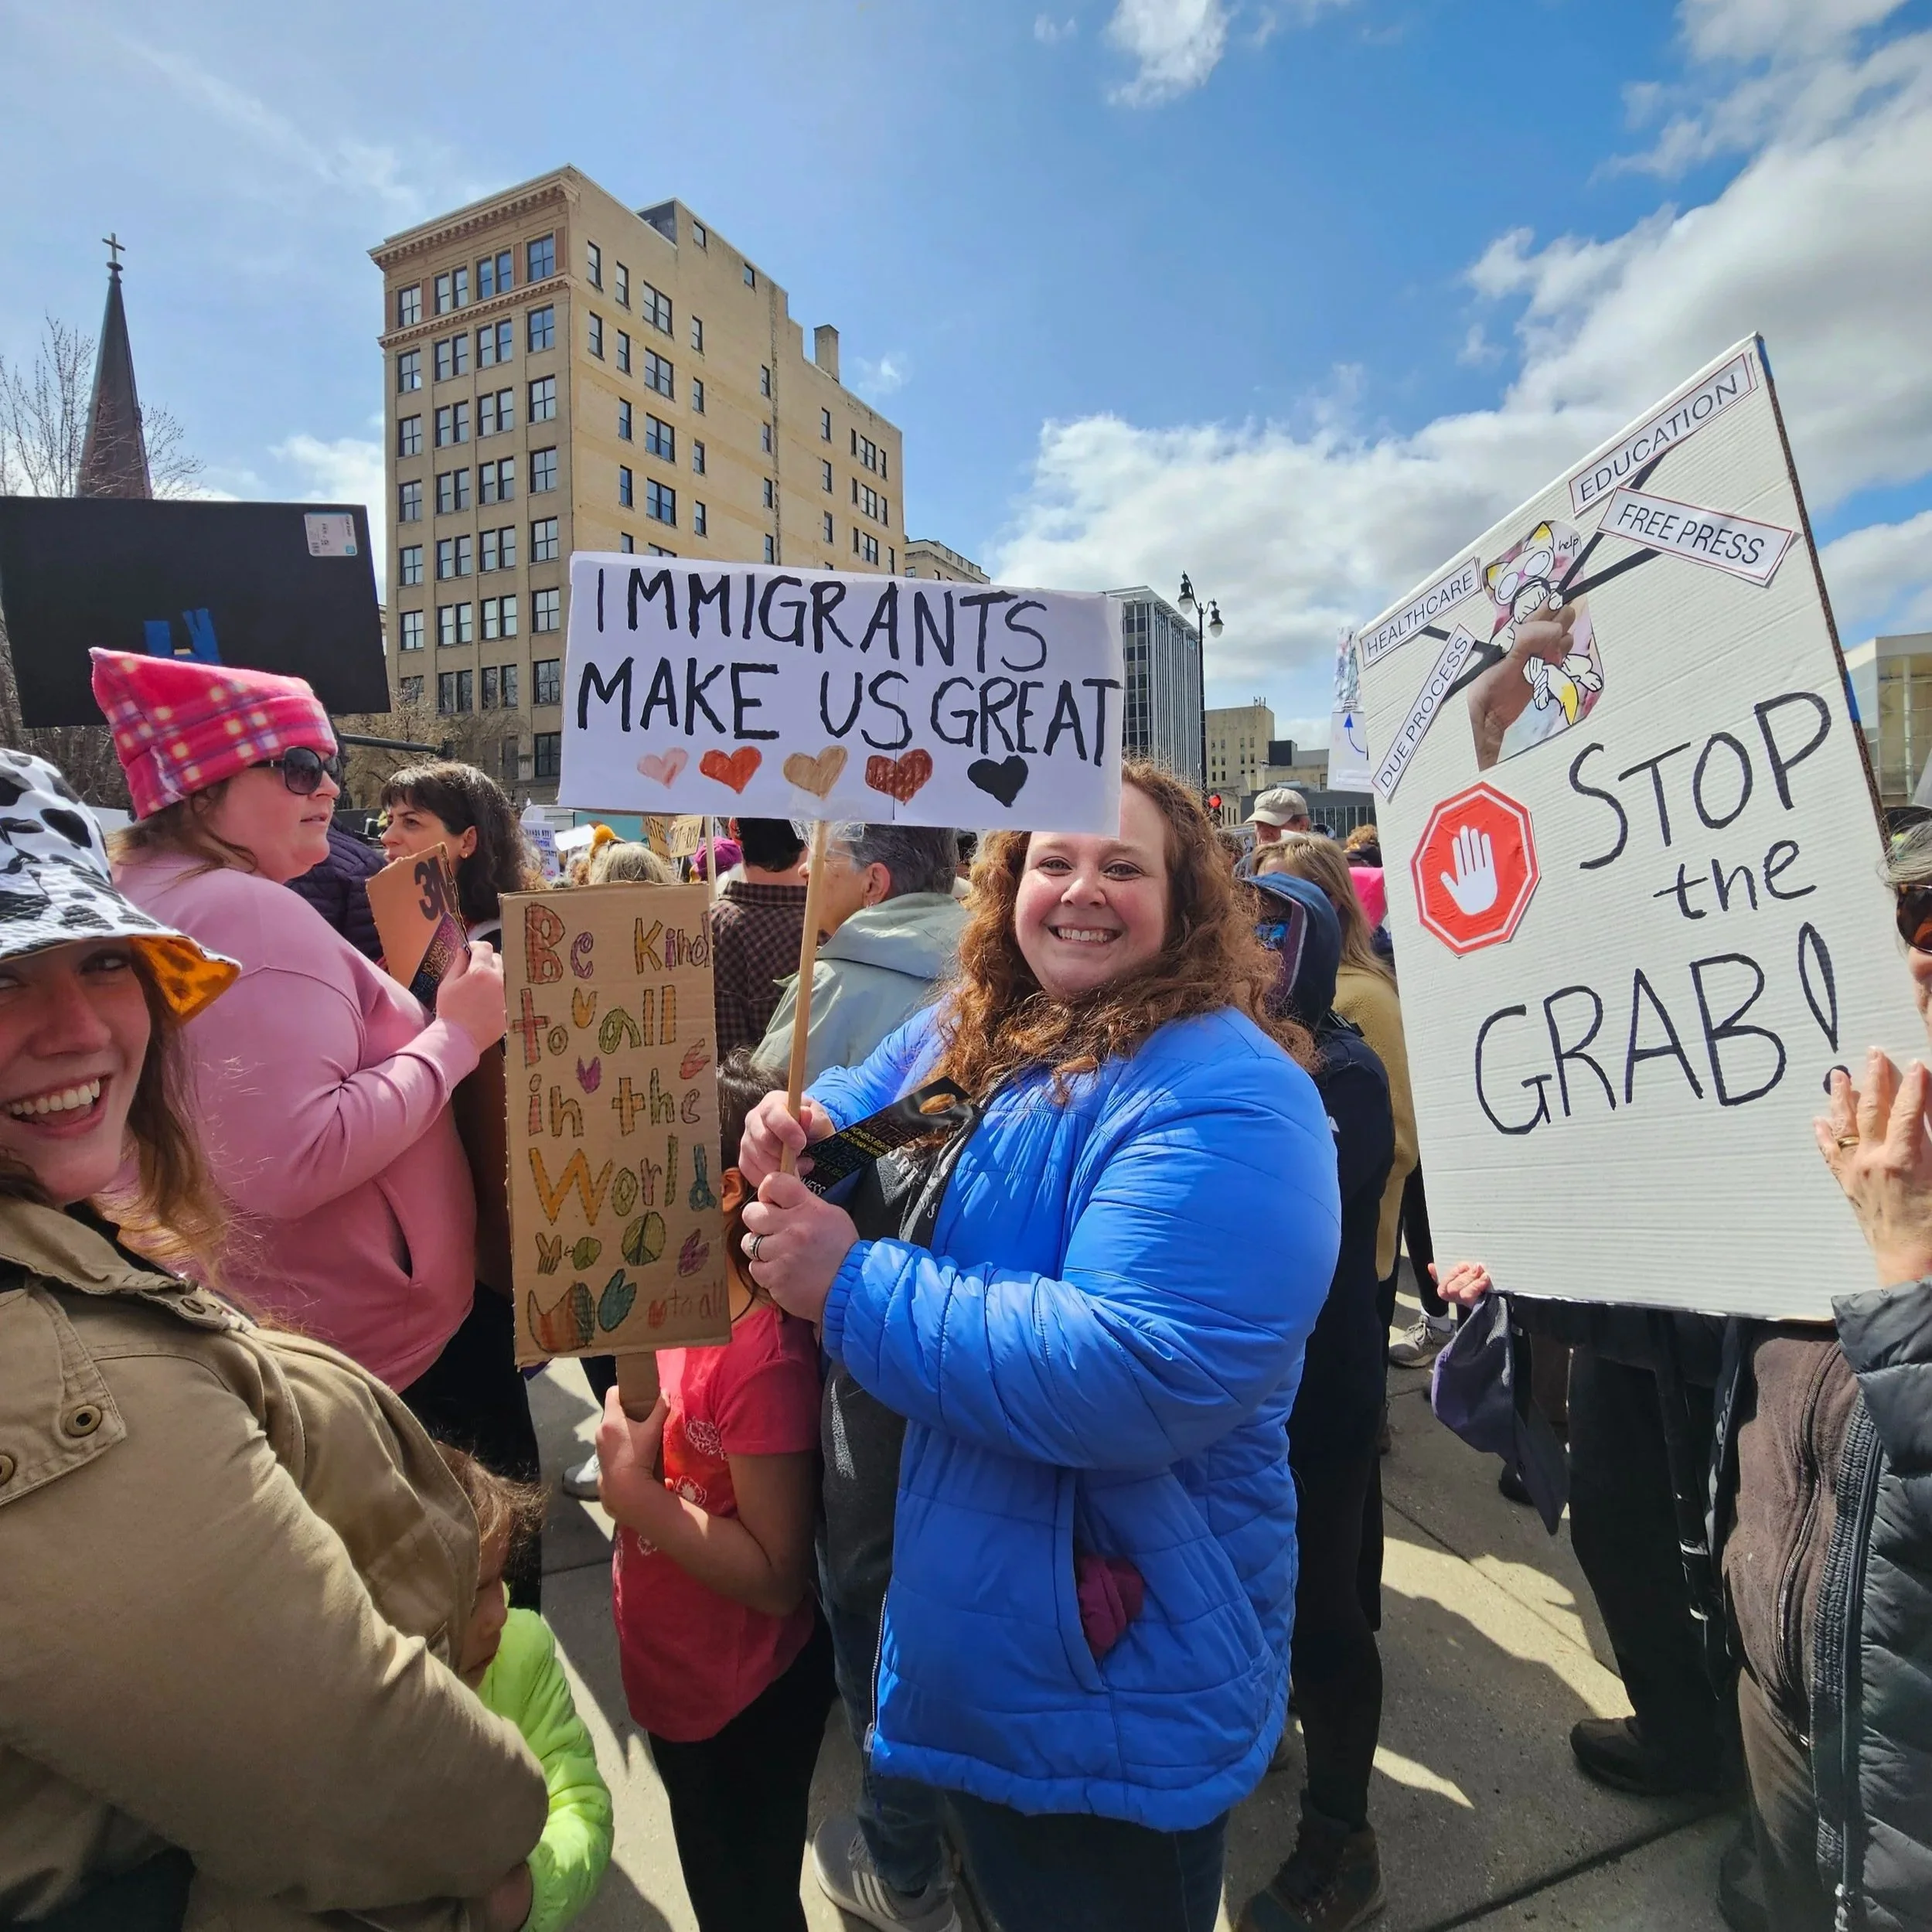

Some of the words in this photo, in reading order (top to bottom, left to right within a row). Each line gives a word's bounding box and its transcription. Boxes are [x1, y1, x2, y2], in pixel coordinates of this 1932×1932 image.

[1579, 374, 1739, 503] EDUCATION
[1558, 535, 1579, 557] help
[1617, 503, 1681, 540] FREE
[1675, 520, 1765, 564] PRESS
[598, 567, 1048, 673] IMMIGRANTS
[1366, 569, 1474, 658] HEALTHCARE
[578, 656, 780, 741] MAKE
[819, 670, 913, 751] US
[930, 676, 1123, 767] GREAT
[1380, 741, 1410, 789] DUE
[1405, 635, 1469, 743] PROCESS
[1569, 691, 1832, 870] STOP
[1653, 839, 1818, 920] the
[524, 901, 595, 984] Be
[633, 910, 712, 975] Kind
[511, 986, 569, 1070] to
[598, 984, 677, 1055] all
[1475, 922, 1853, 1135] GRAB!
[527, 1073, 585, 1138] in
[612, 1067, 701, 1137] the
[529, 1133, 718, 1227] World
